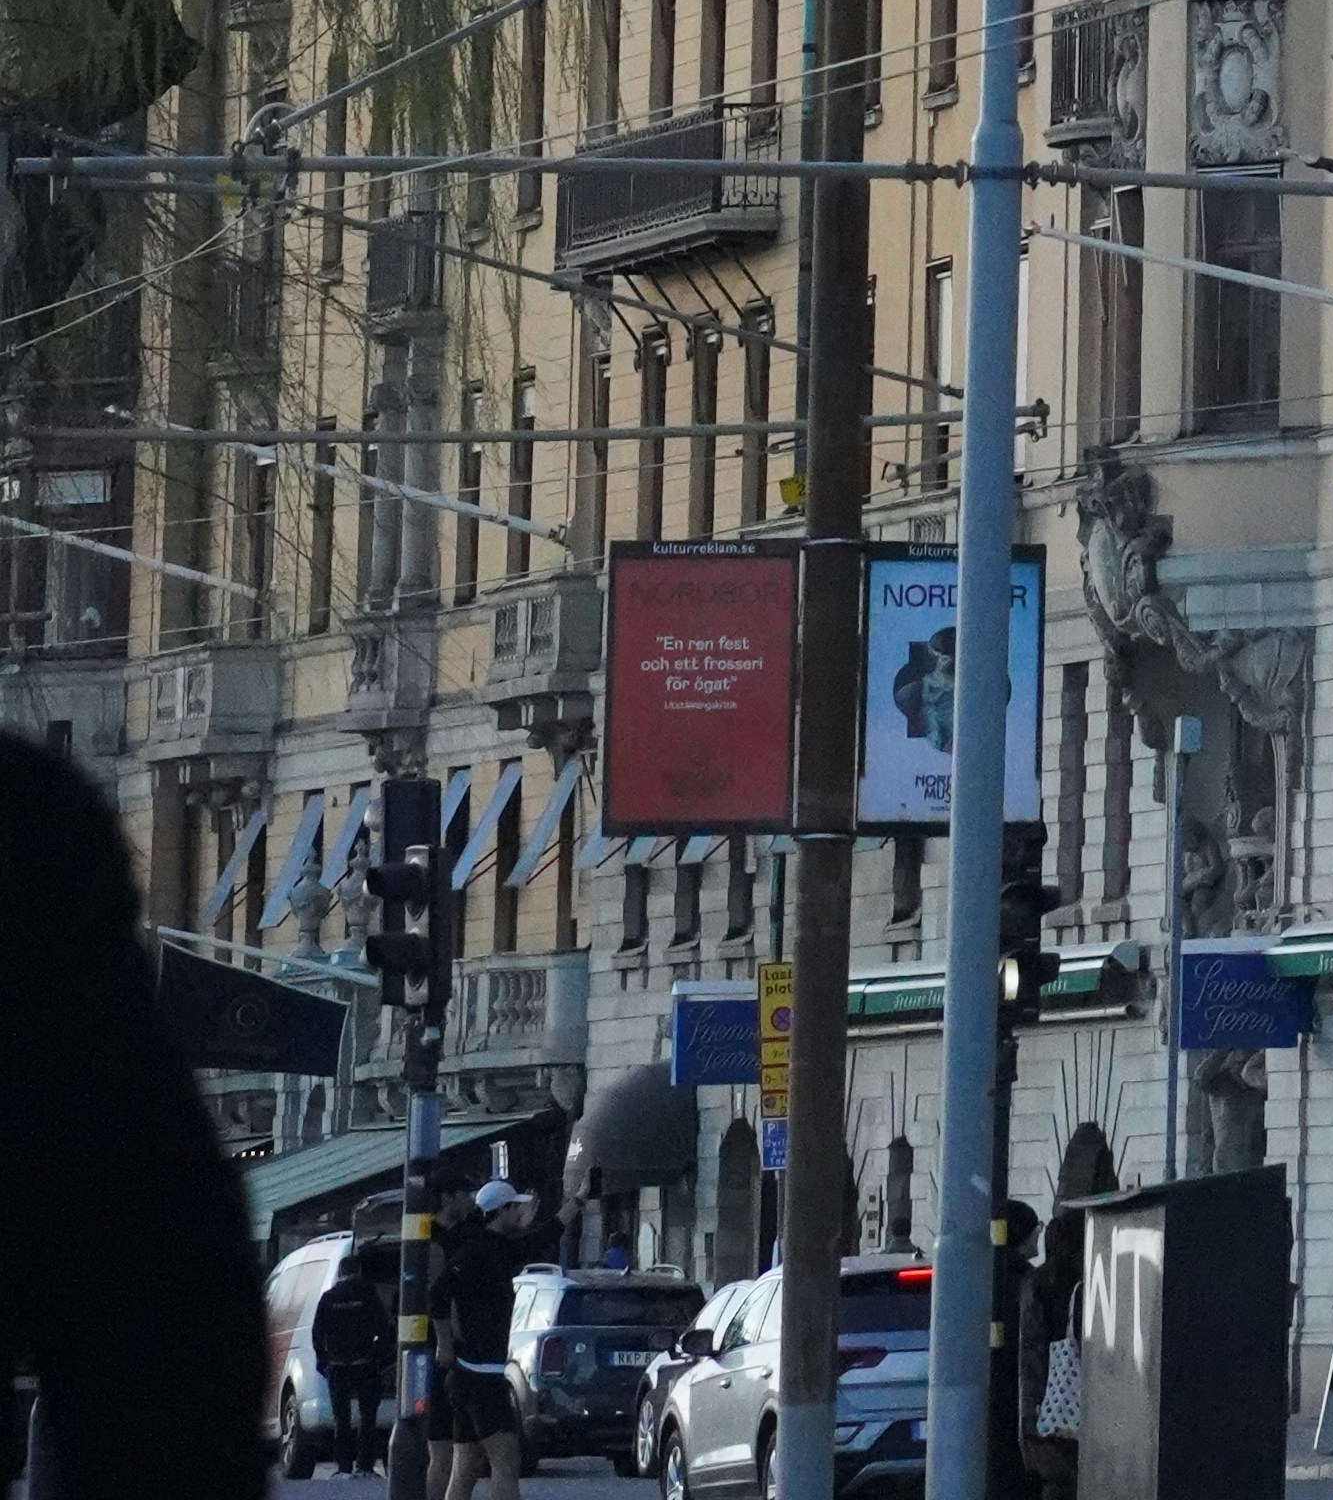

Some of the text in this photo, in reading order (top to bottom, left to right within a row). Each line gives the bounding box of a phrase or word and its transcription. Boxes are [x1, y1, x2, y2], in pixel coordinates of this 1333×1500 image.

[652, 542, 756, 555] kulturreklam.se
[687, 639, 714, 650] ren
[719, 636, 750, 650] fest
[640, 656, 763, 671] och ett frosseri
[665, 676, 690, 691] för
